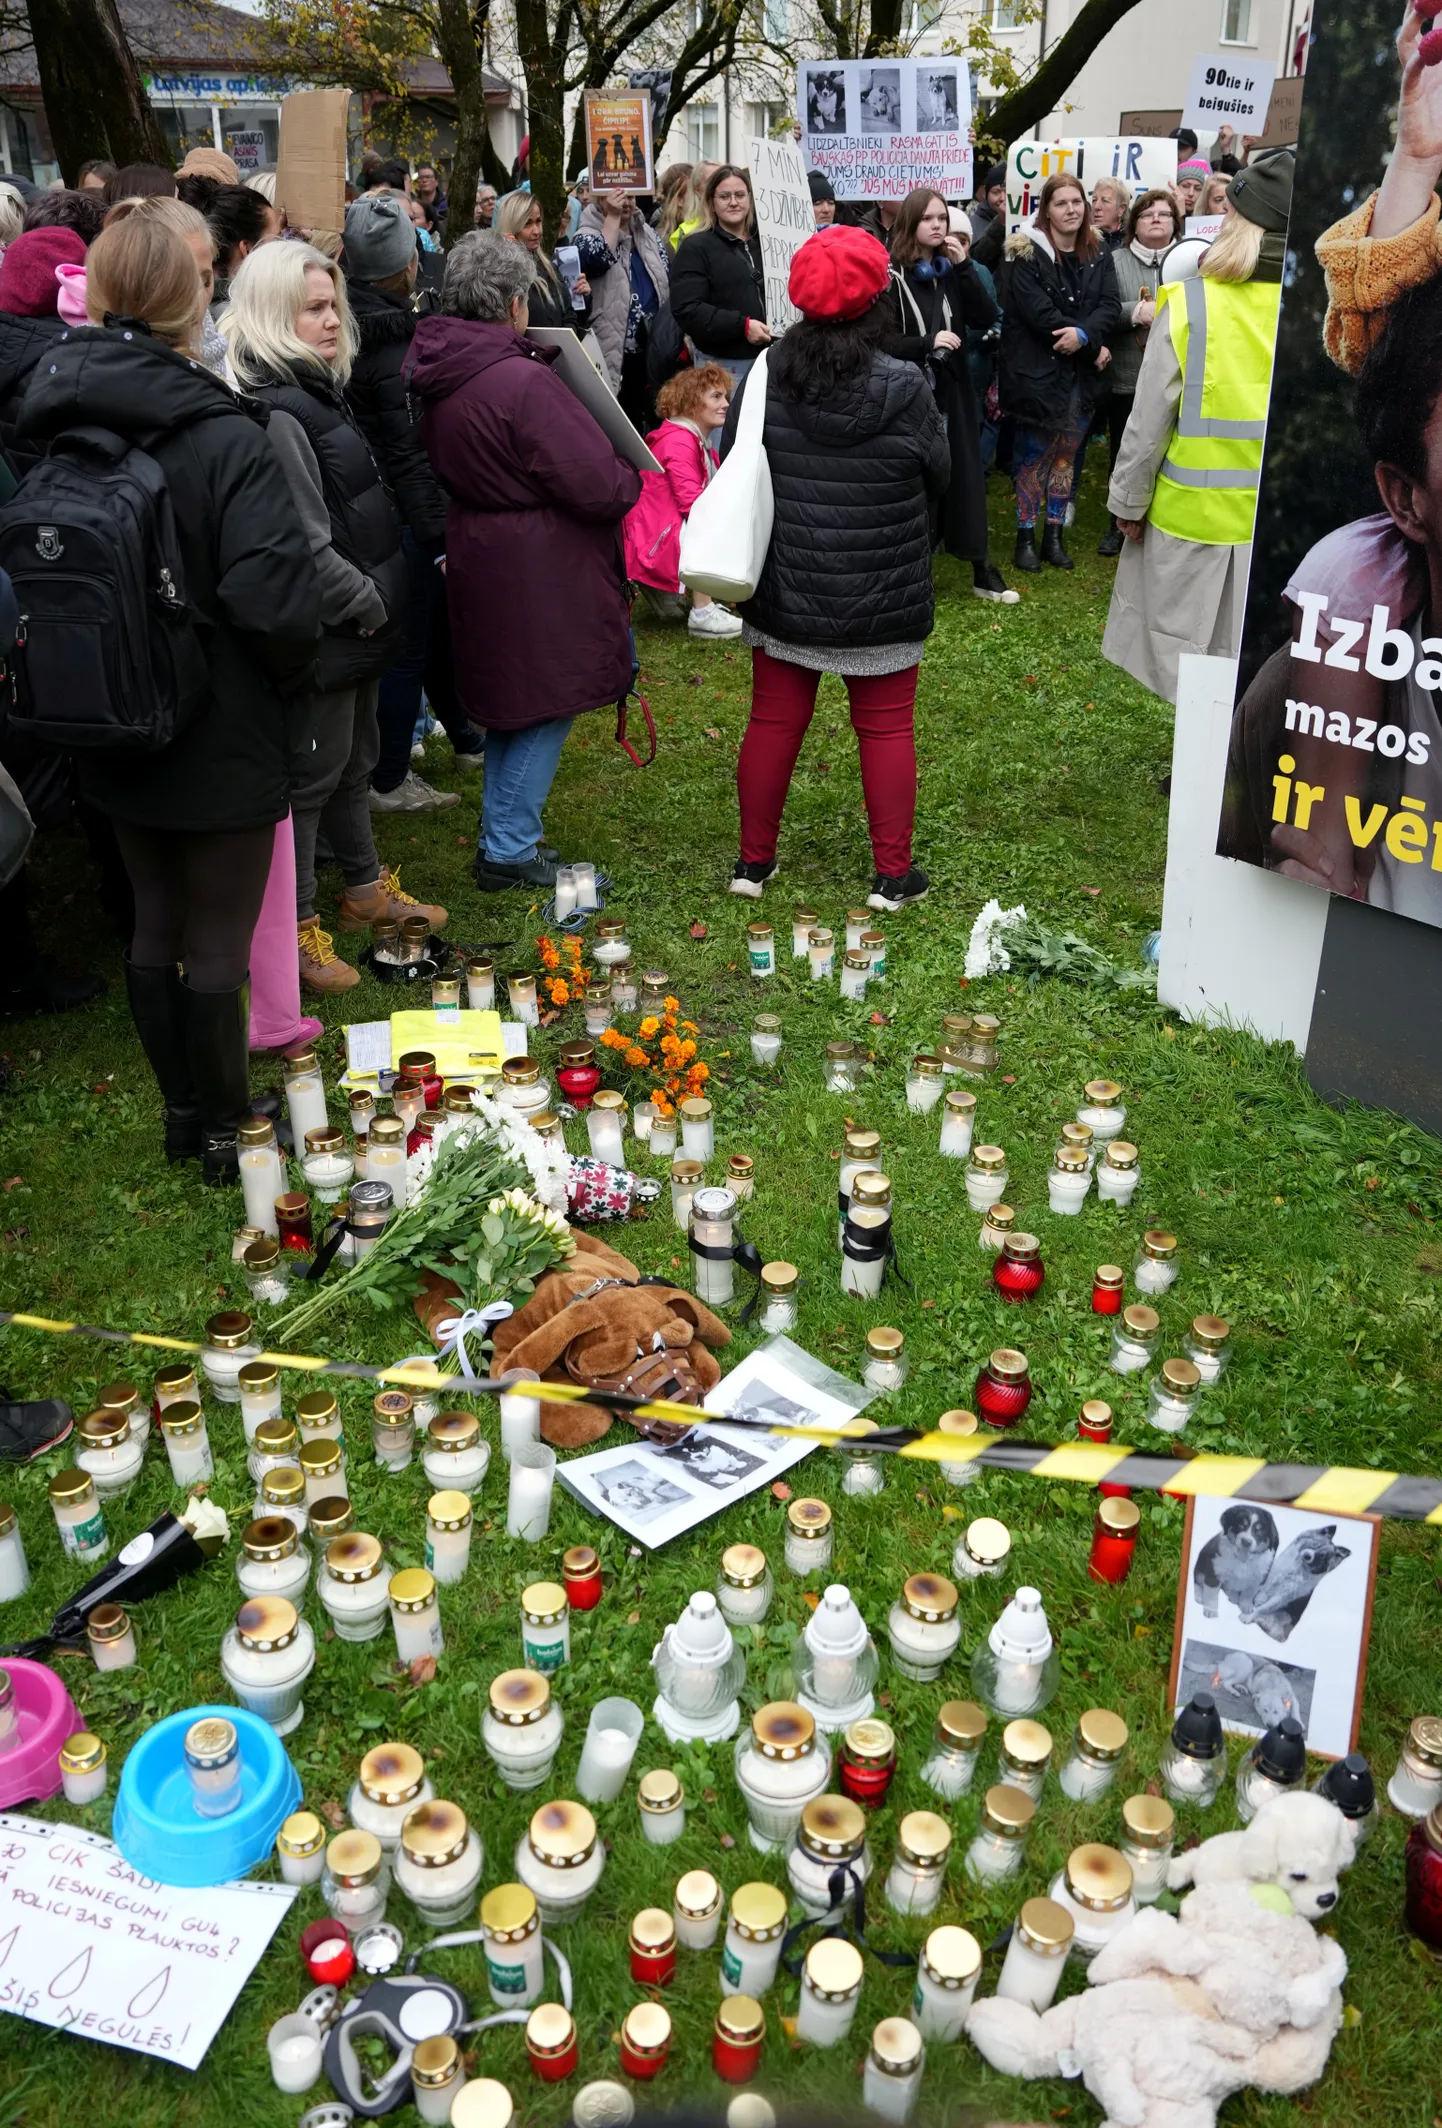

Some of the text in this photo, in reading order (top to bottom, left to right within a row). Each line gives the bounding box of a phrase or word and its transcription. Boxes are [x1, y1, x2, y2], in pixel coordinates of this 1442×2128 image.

[1205, 67, 1254, 91] 90tie ir
[1198, 96, 1254, 115] beigušies
[856, 150, 868, 166] PP
[855, 165, 886, 179] DRAUD
[1290, 590, 1442, 692] Izba
[1284, 698, 1431, 765] mazos
[1271, 754, 1325, 831] ir
[48, 1844, 90, 1869] CIK
[0, 1866, 15, 1885] Ā
